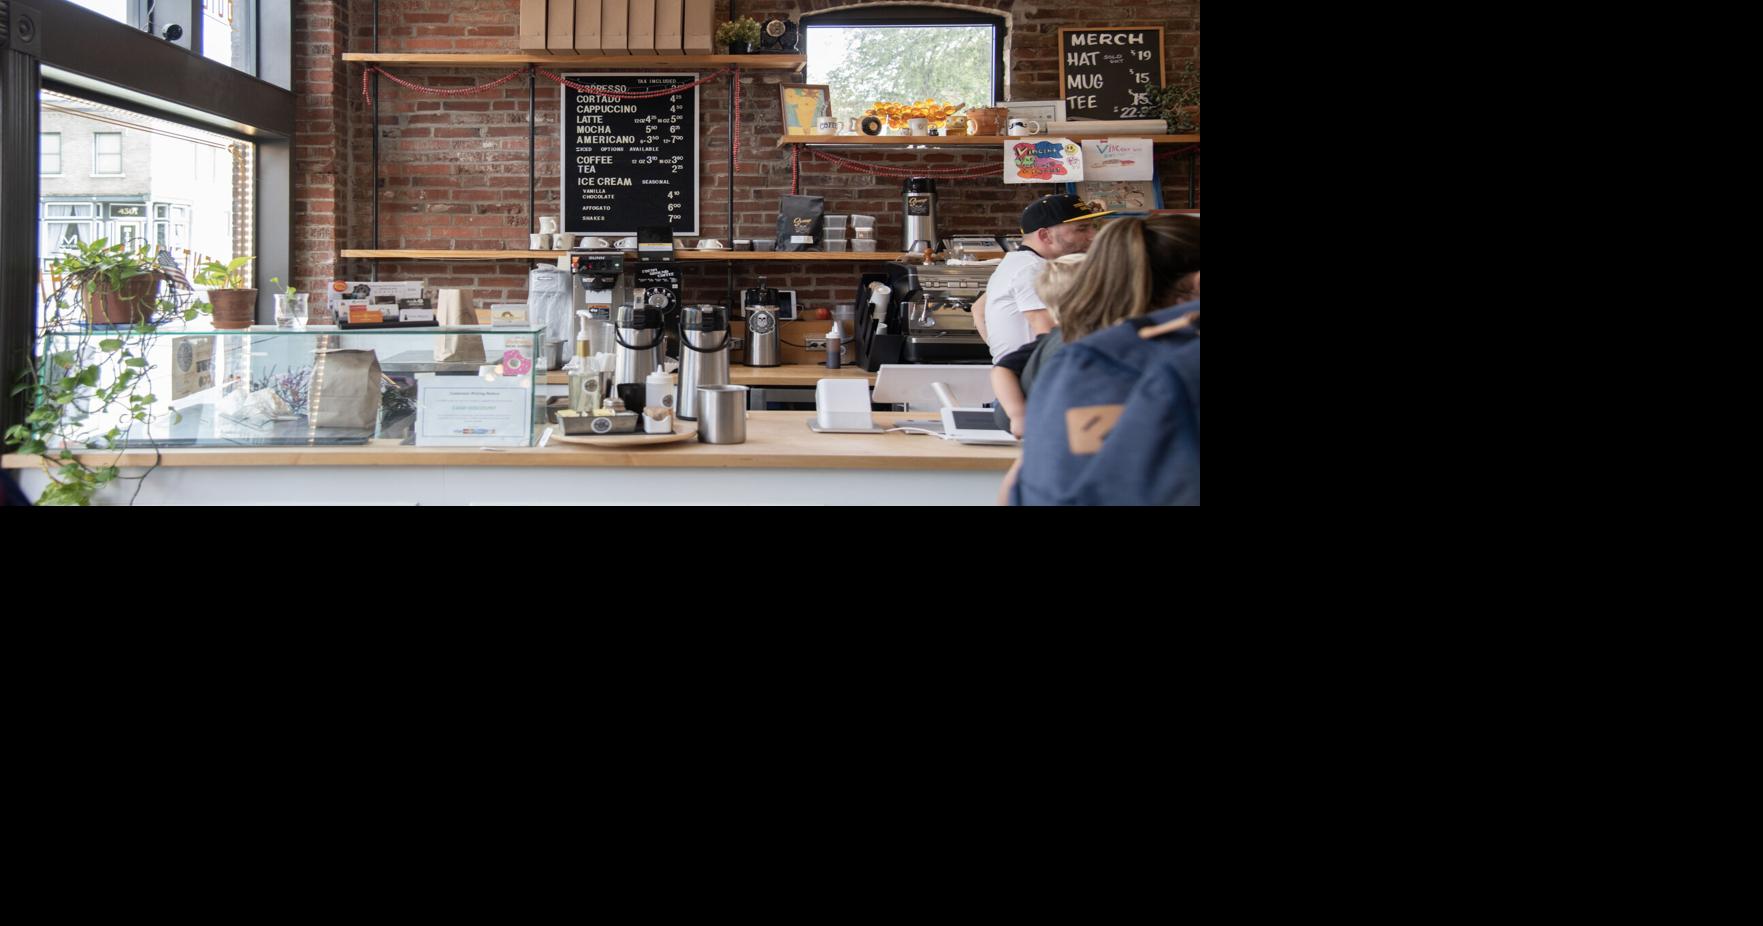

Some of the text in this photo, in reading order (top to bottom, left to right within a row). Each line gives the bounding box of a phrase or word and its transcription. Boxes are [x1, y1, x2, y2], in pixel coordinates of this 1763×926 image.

[1072, 34, 1143, 46] MERCH
[1067, 52, 1100, 66] HAT
[1068, 74, 1103, 89] MUG
[577, 95, 621, 103] CORTADO
[1067, 95, 1096, 109] TEE
[577, 105, 637, 113] CAPPUCCINO
[577, 115, 603, 123] LATTE
[577, 156, 613, 164] COFFEE
[578, 165, 596, 173] TEA
[597, 177, 632, 186] CREAM
